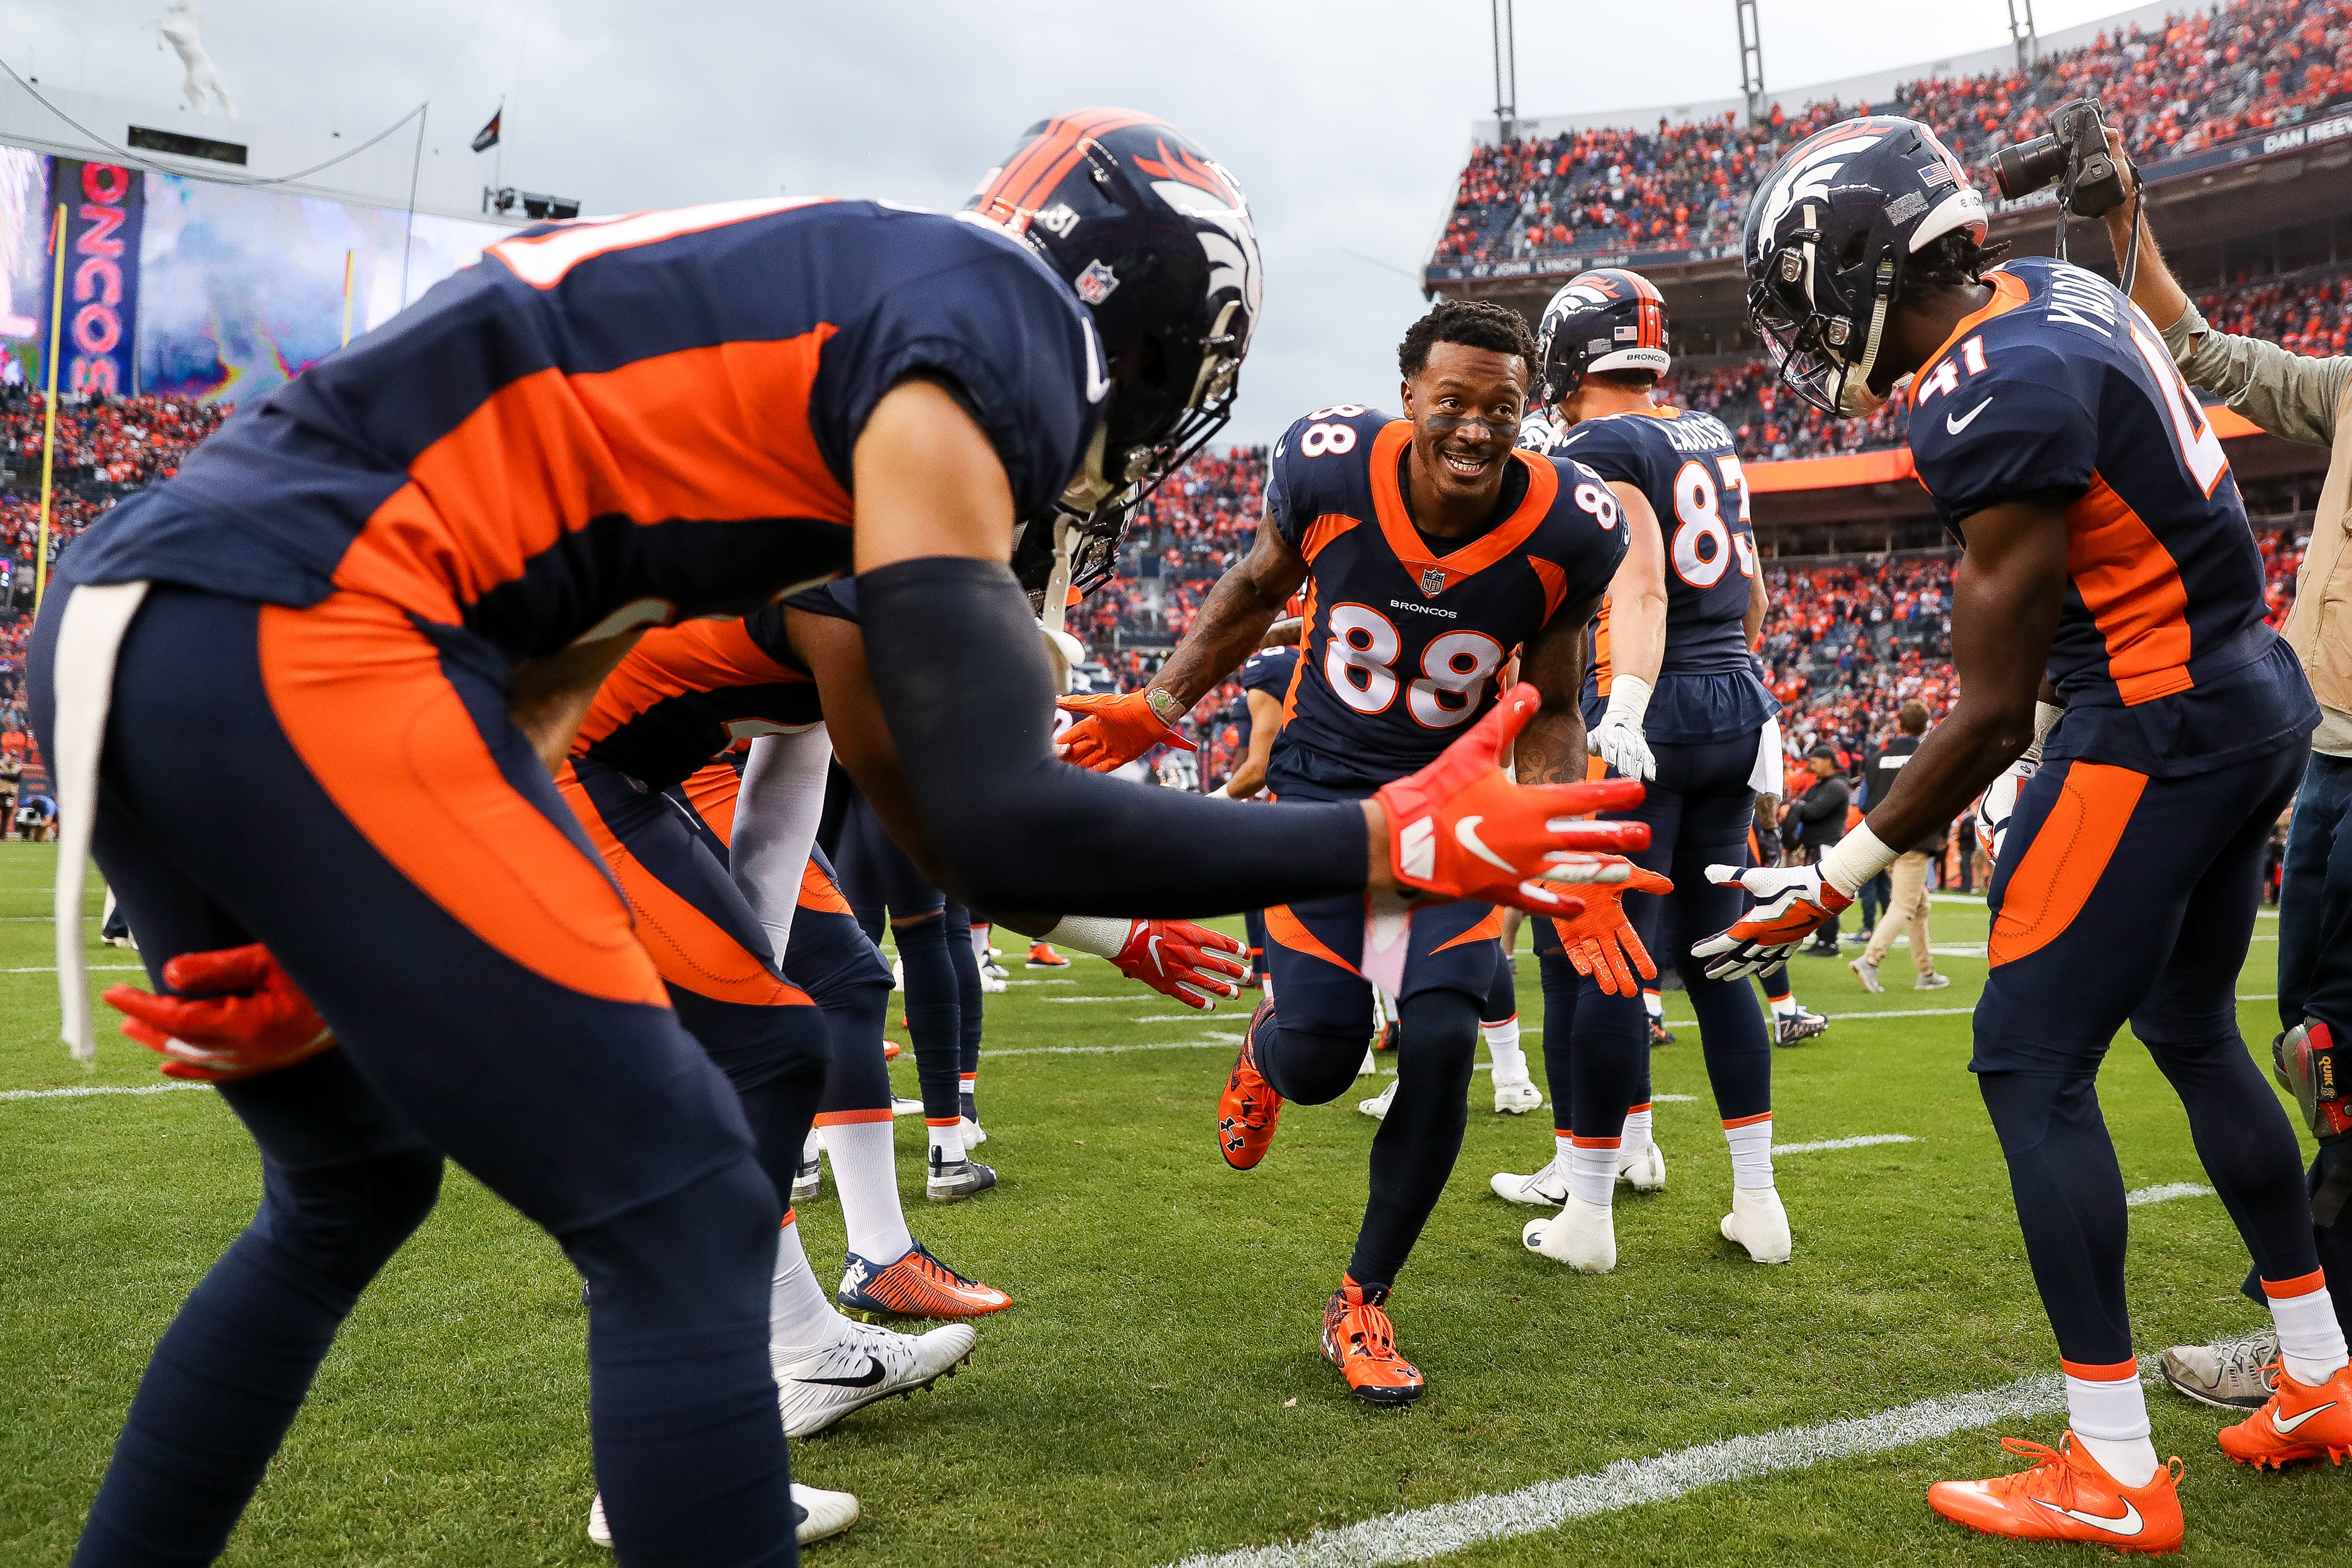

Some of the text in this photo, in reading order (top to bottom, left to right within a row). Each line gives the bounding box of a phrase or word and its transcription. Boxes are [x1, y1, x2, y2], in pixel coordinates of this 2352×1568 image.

[2263, 127, 2305, 154] DAN
[1627, 354, 1666, 363] BRONCOS
[1917, 334, 1989, 407] 41
[1300, 403, 1366, 458] 88
[1671, 455, 1754, 589] 83
[1390, 599, 1458, 619] BRONCOS
[1326, 602, 1505, 730] 88
[2319, 1056, 2333, 1085] QUIK
